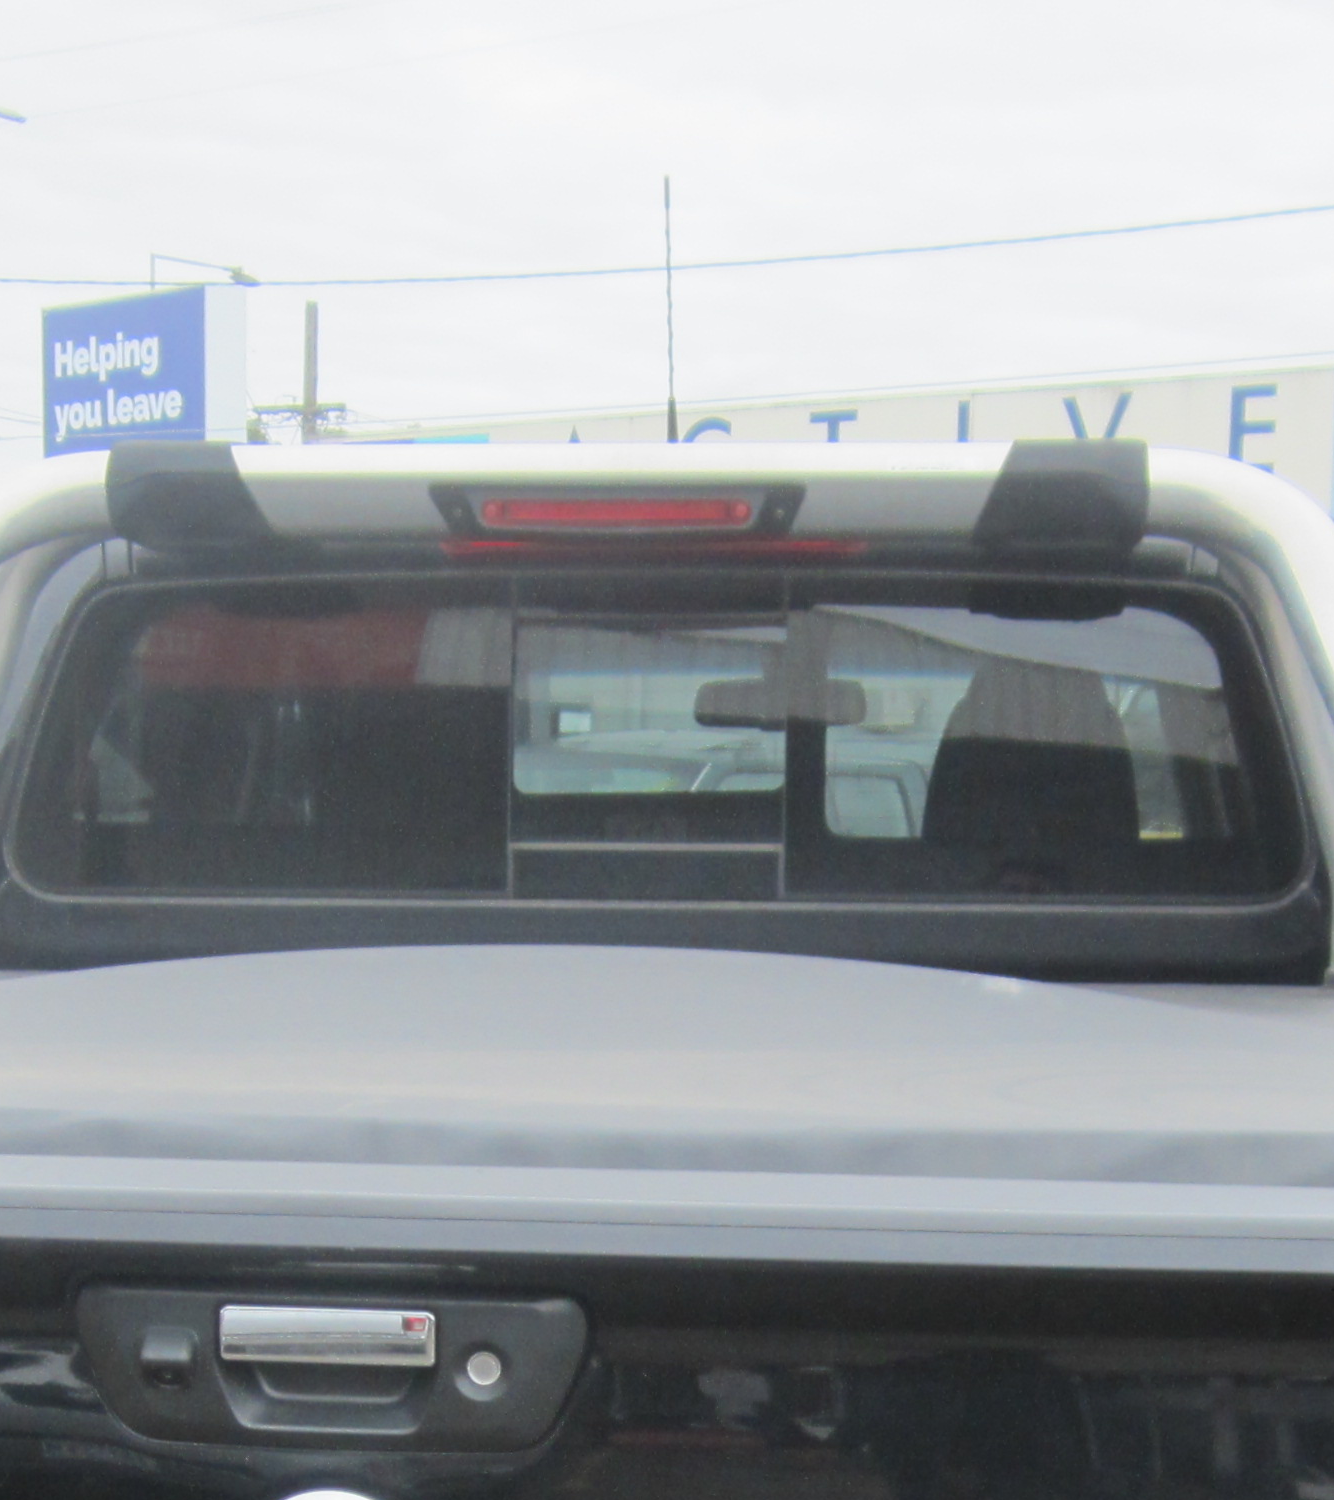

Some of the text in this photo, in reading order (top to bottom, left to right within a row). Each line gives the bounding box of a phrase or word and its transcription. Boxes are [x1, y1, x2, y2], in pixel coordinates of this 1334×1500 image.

[53, 331, 160, 382] Helping
[53, 388, 183, 442] you leave
